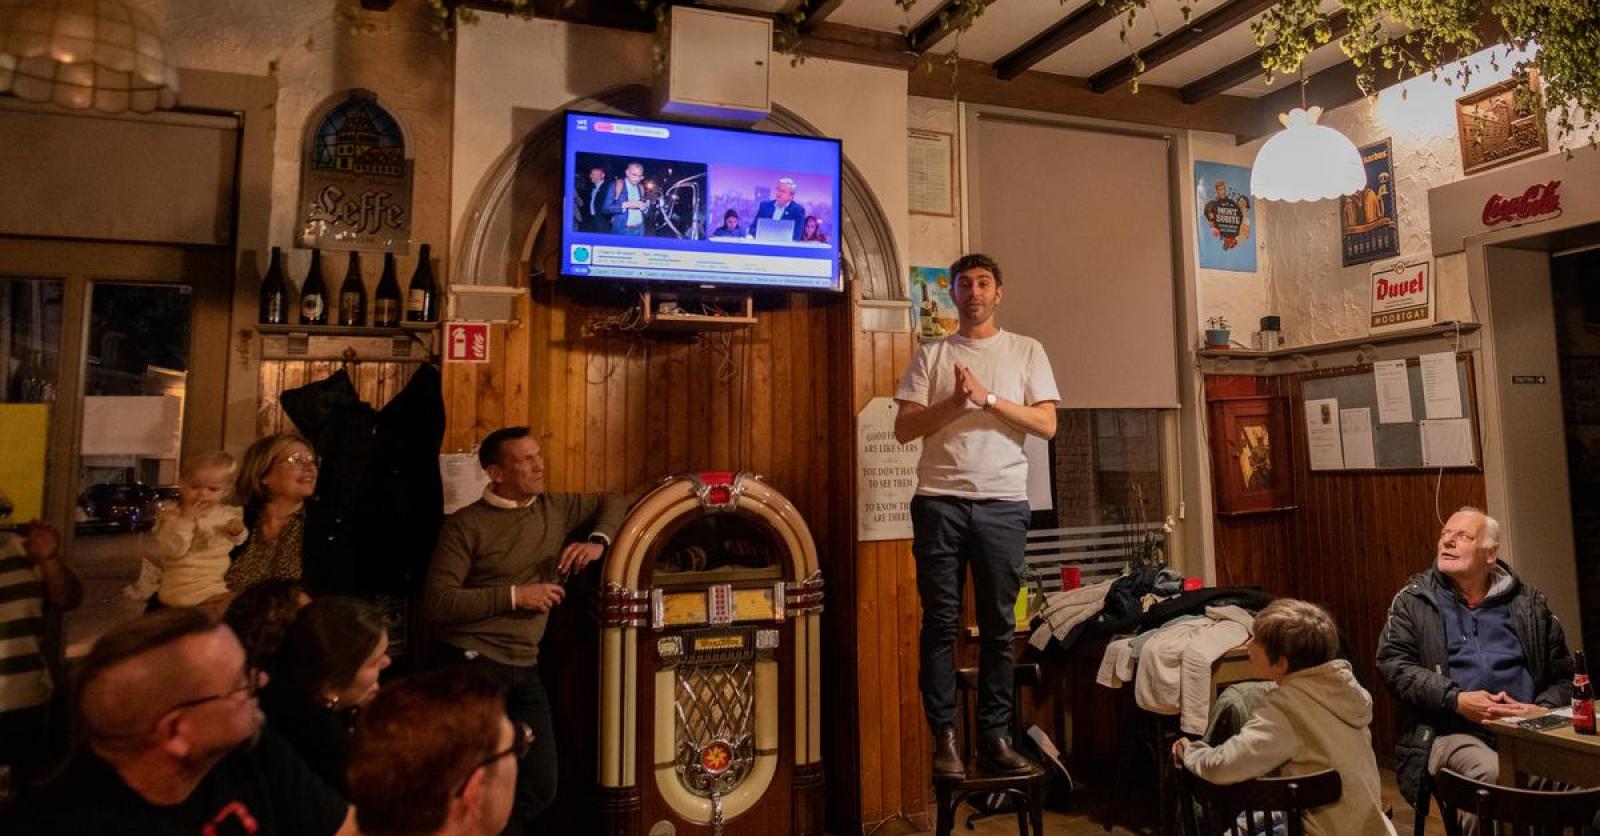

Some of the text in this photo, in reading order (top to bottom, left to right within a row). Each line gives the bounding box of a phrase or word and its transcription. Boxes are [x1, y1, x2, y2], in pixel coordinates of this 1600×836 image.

[309, 184, 404, 234] Leffe
[1376, 270, 1424, 300] Duvel
[1375, 309, 1425, 323] MOORTGAT
[866, 431, 886, 442] GOOD
[864, 443, 878, 453] ARE
[879, 443, 896, 453] LIKE
[863, 467, 877, 477] YOU
[868, 479, 913, 489] TO SEE THEM
[865, 503, 876, 513] TO
[877, 502, 897, 512] KNOW
[874, 513, 886, 522] ARE
